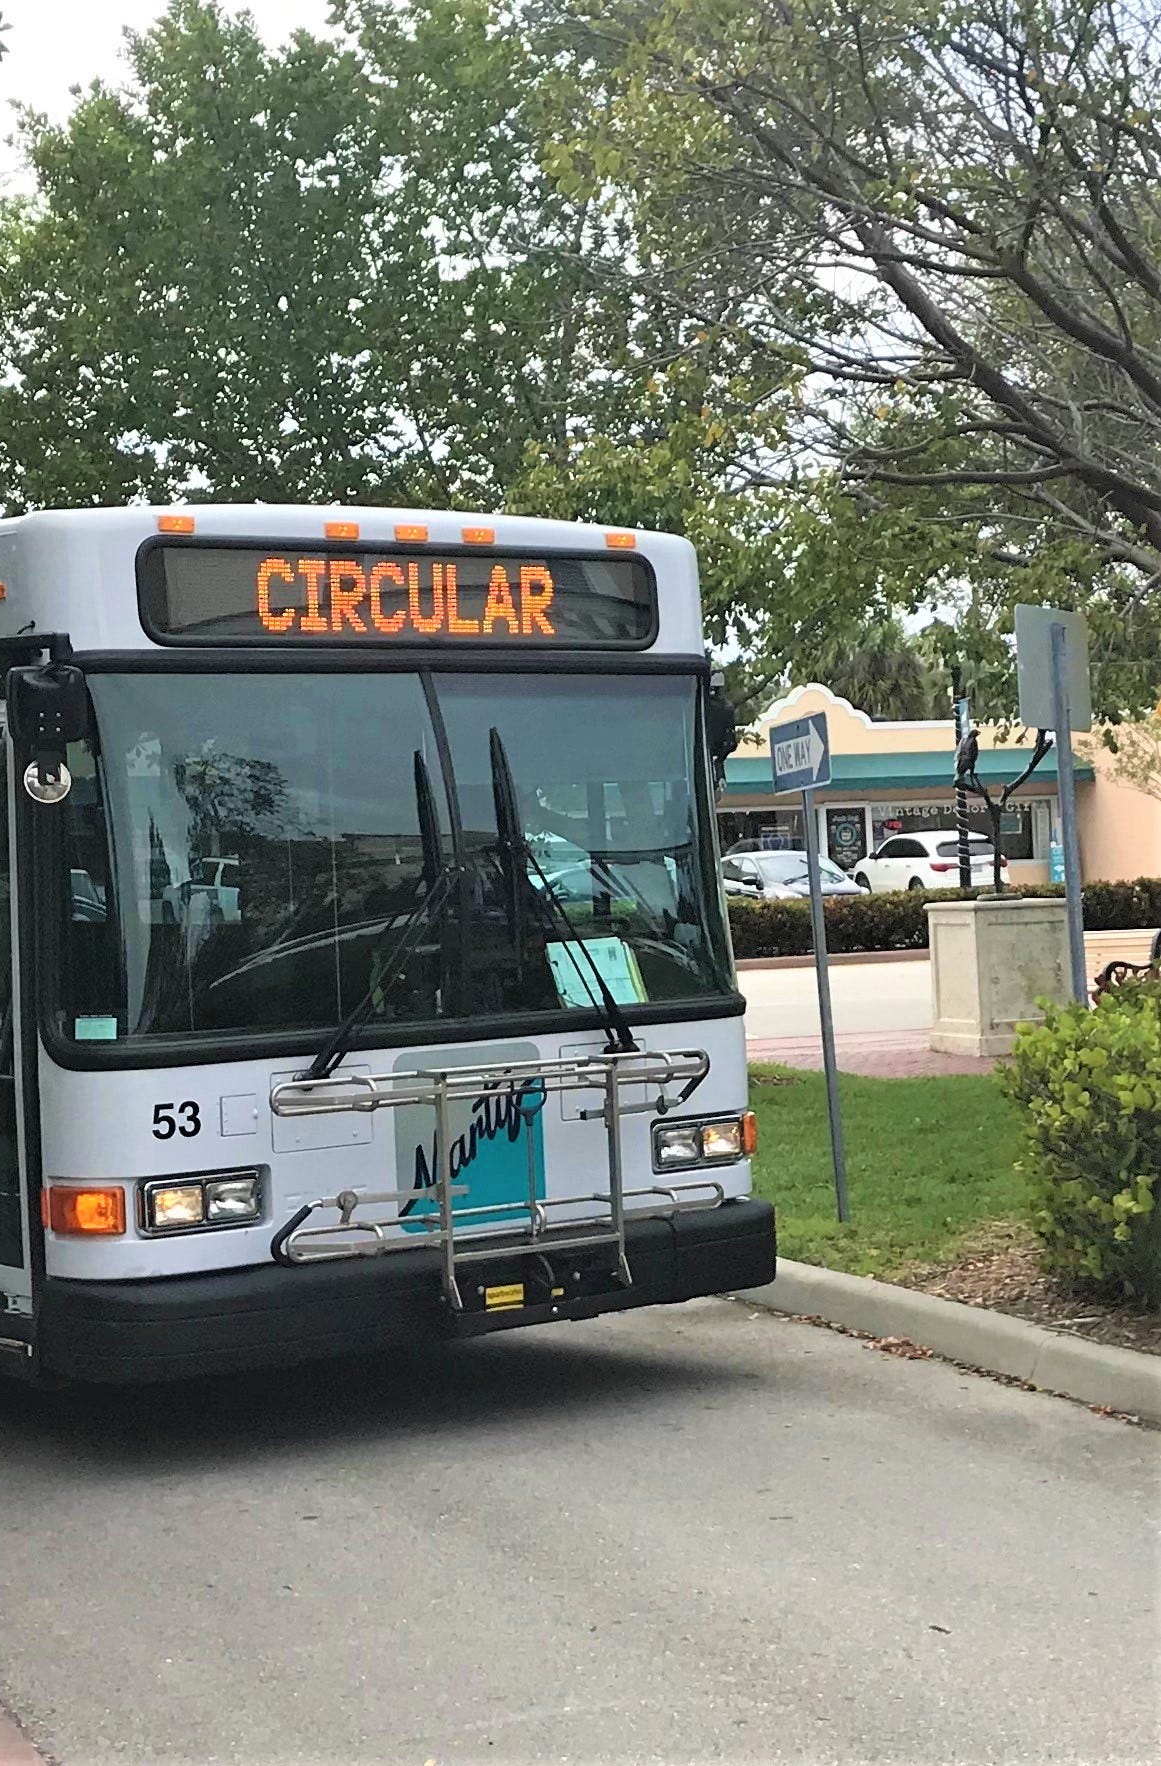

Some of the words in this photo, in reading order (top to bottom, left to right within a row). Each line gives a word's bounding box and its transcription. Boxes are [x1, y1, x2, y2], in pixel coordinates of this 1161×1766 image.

[256, 557, 556, 635] CIRCULAR
[777, 743, 794, 771] ONE
[793, 738, 811, 767] WAY
[152, 1100, 202, 1140] 53
